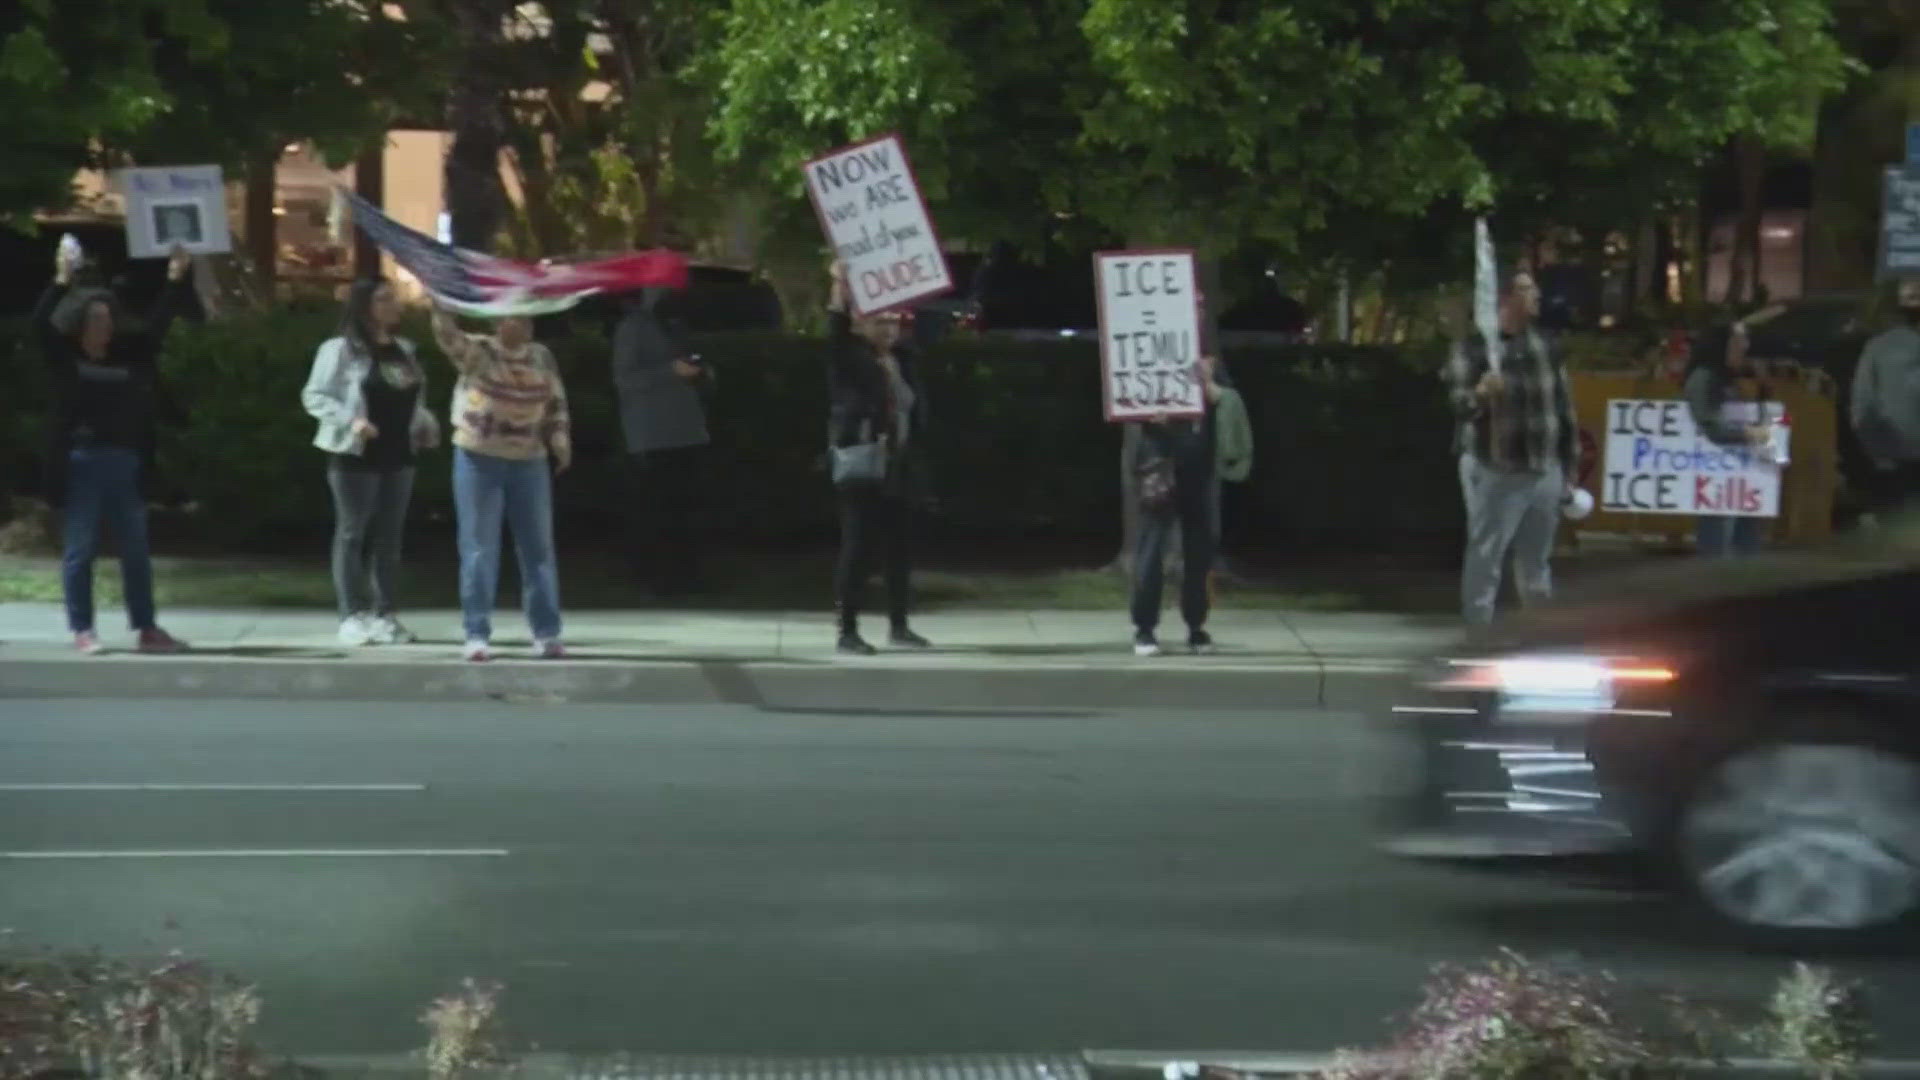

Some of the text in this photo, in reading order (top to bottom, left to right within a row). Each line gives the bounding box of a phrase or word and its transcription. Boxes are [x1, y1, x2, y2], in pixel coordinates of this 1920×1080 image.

[815, 148, 890, 194] NOW
[866, 174, 909, 210] ARE
[861, 253, 941, 299] DUDE!
[1114, 261, 1181, 297] ICE
[1113, 330, 1190, 368] TEMU
[1612, 402, 1681, 437] ICE
[1603, 473, 1762, 512] ICE Kills
